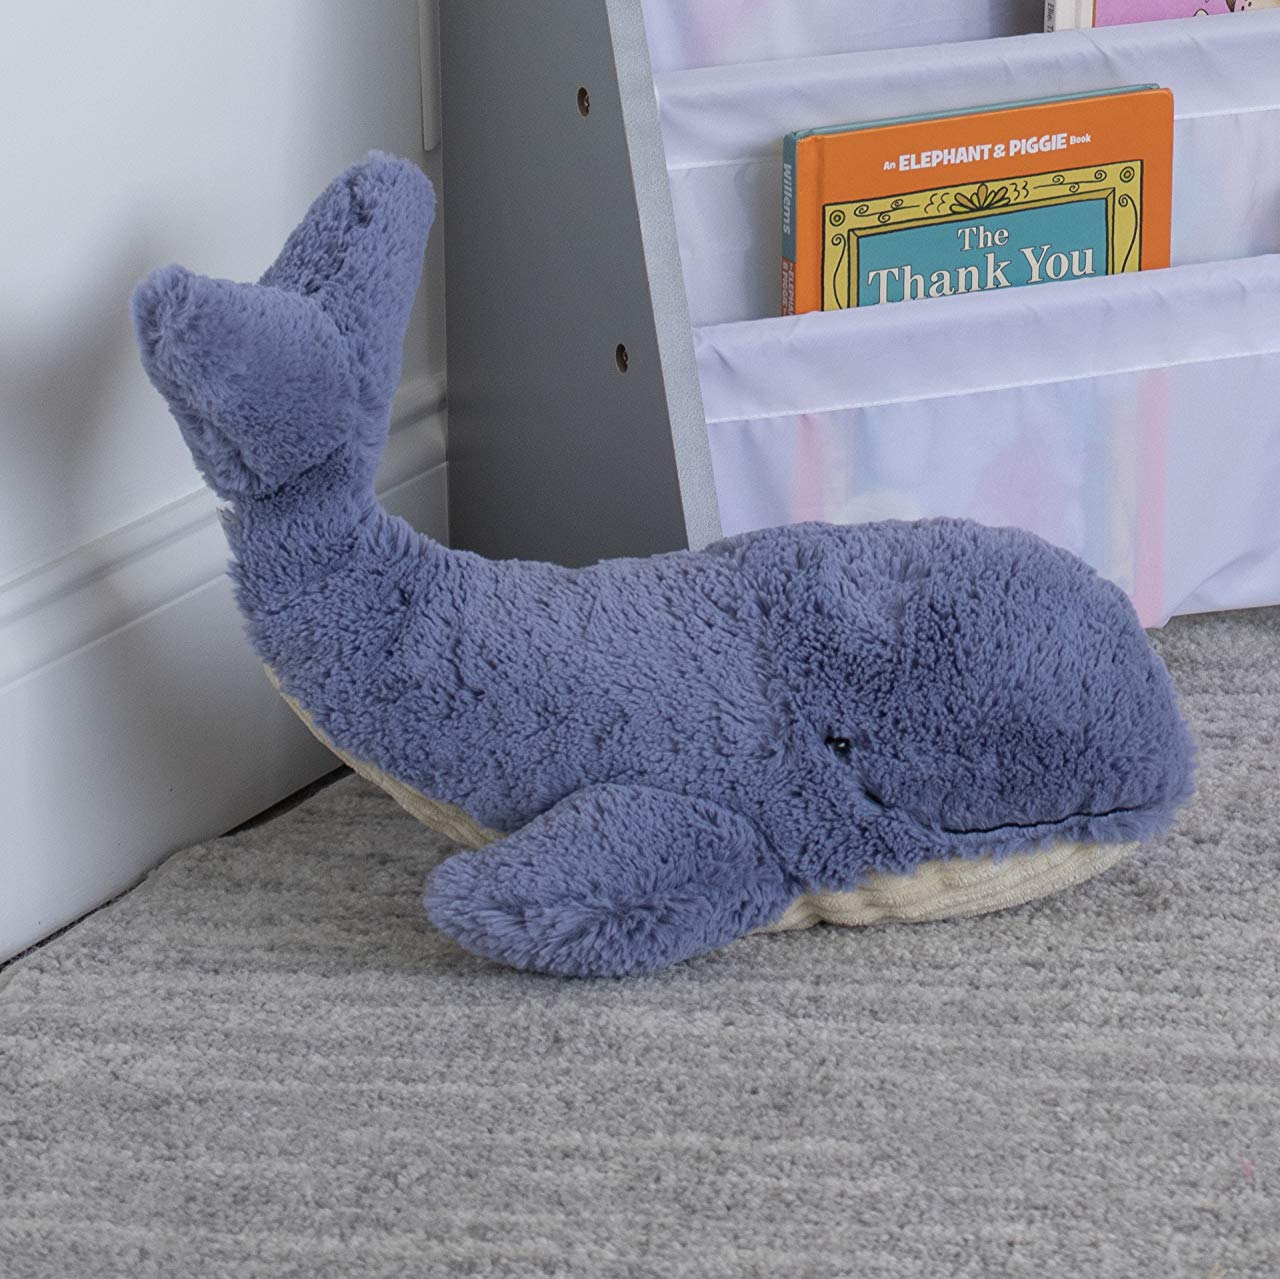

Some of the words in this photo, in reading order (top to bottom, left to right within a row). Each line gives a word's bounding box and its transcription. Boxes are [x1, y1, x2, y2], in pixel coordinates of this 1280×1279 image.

[883, 160, 896, 171] An
[898, 143, 992, 172] ELEPHANT
[993, 143, 1006, 159] &
[1009, 132, 1068, 157] PIGGIE
[1069, 133, 1092, 145] Book
[783, 162, 793, 235] Willems
[957, 225, 1010, 252] The
[787, 270, 795, 315] ELEPHA
[867, 252, 1013, 305] Thank
[1019, 244, 1096, 285] You
